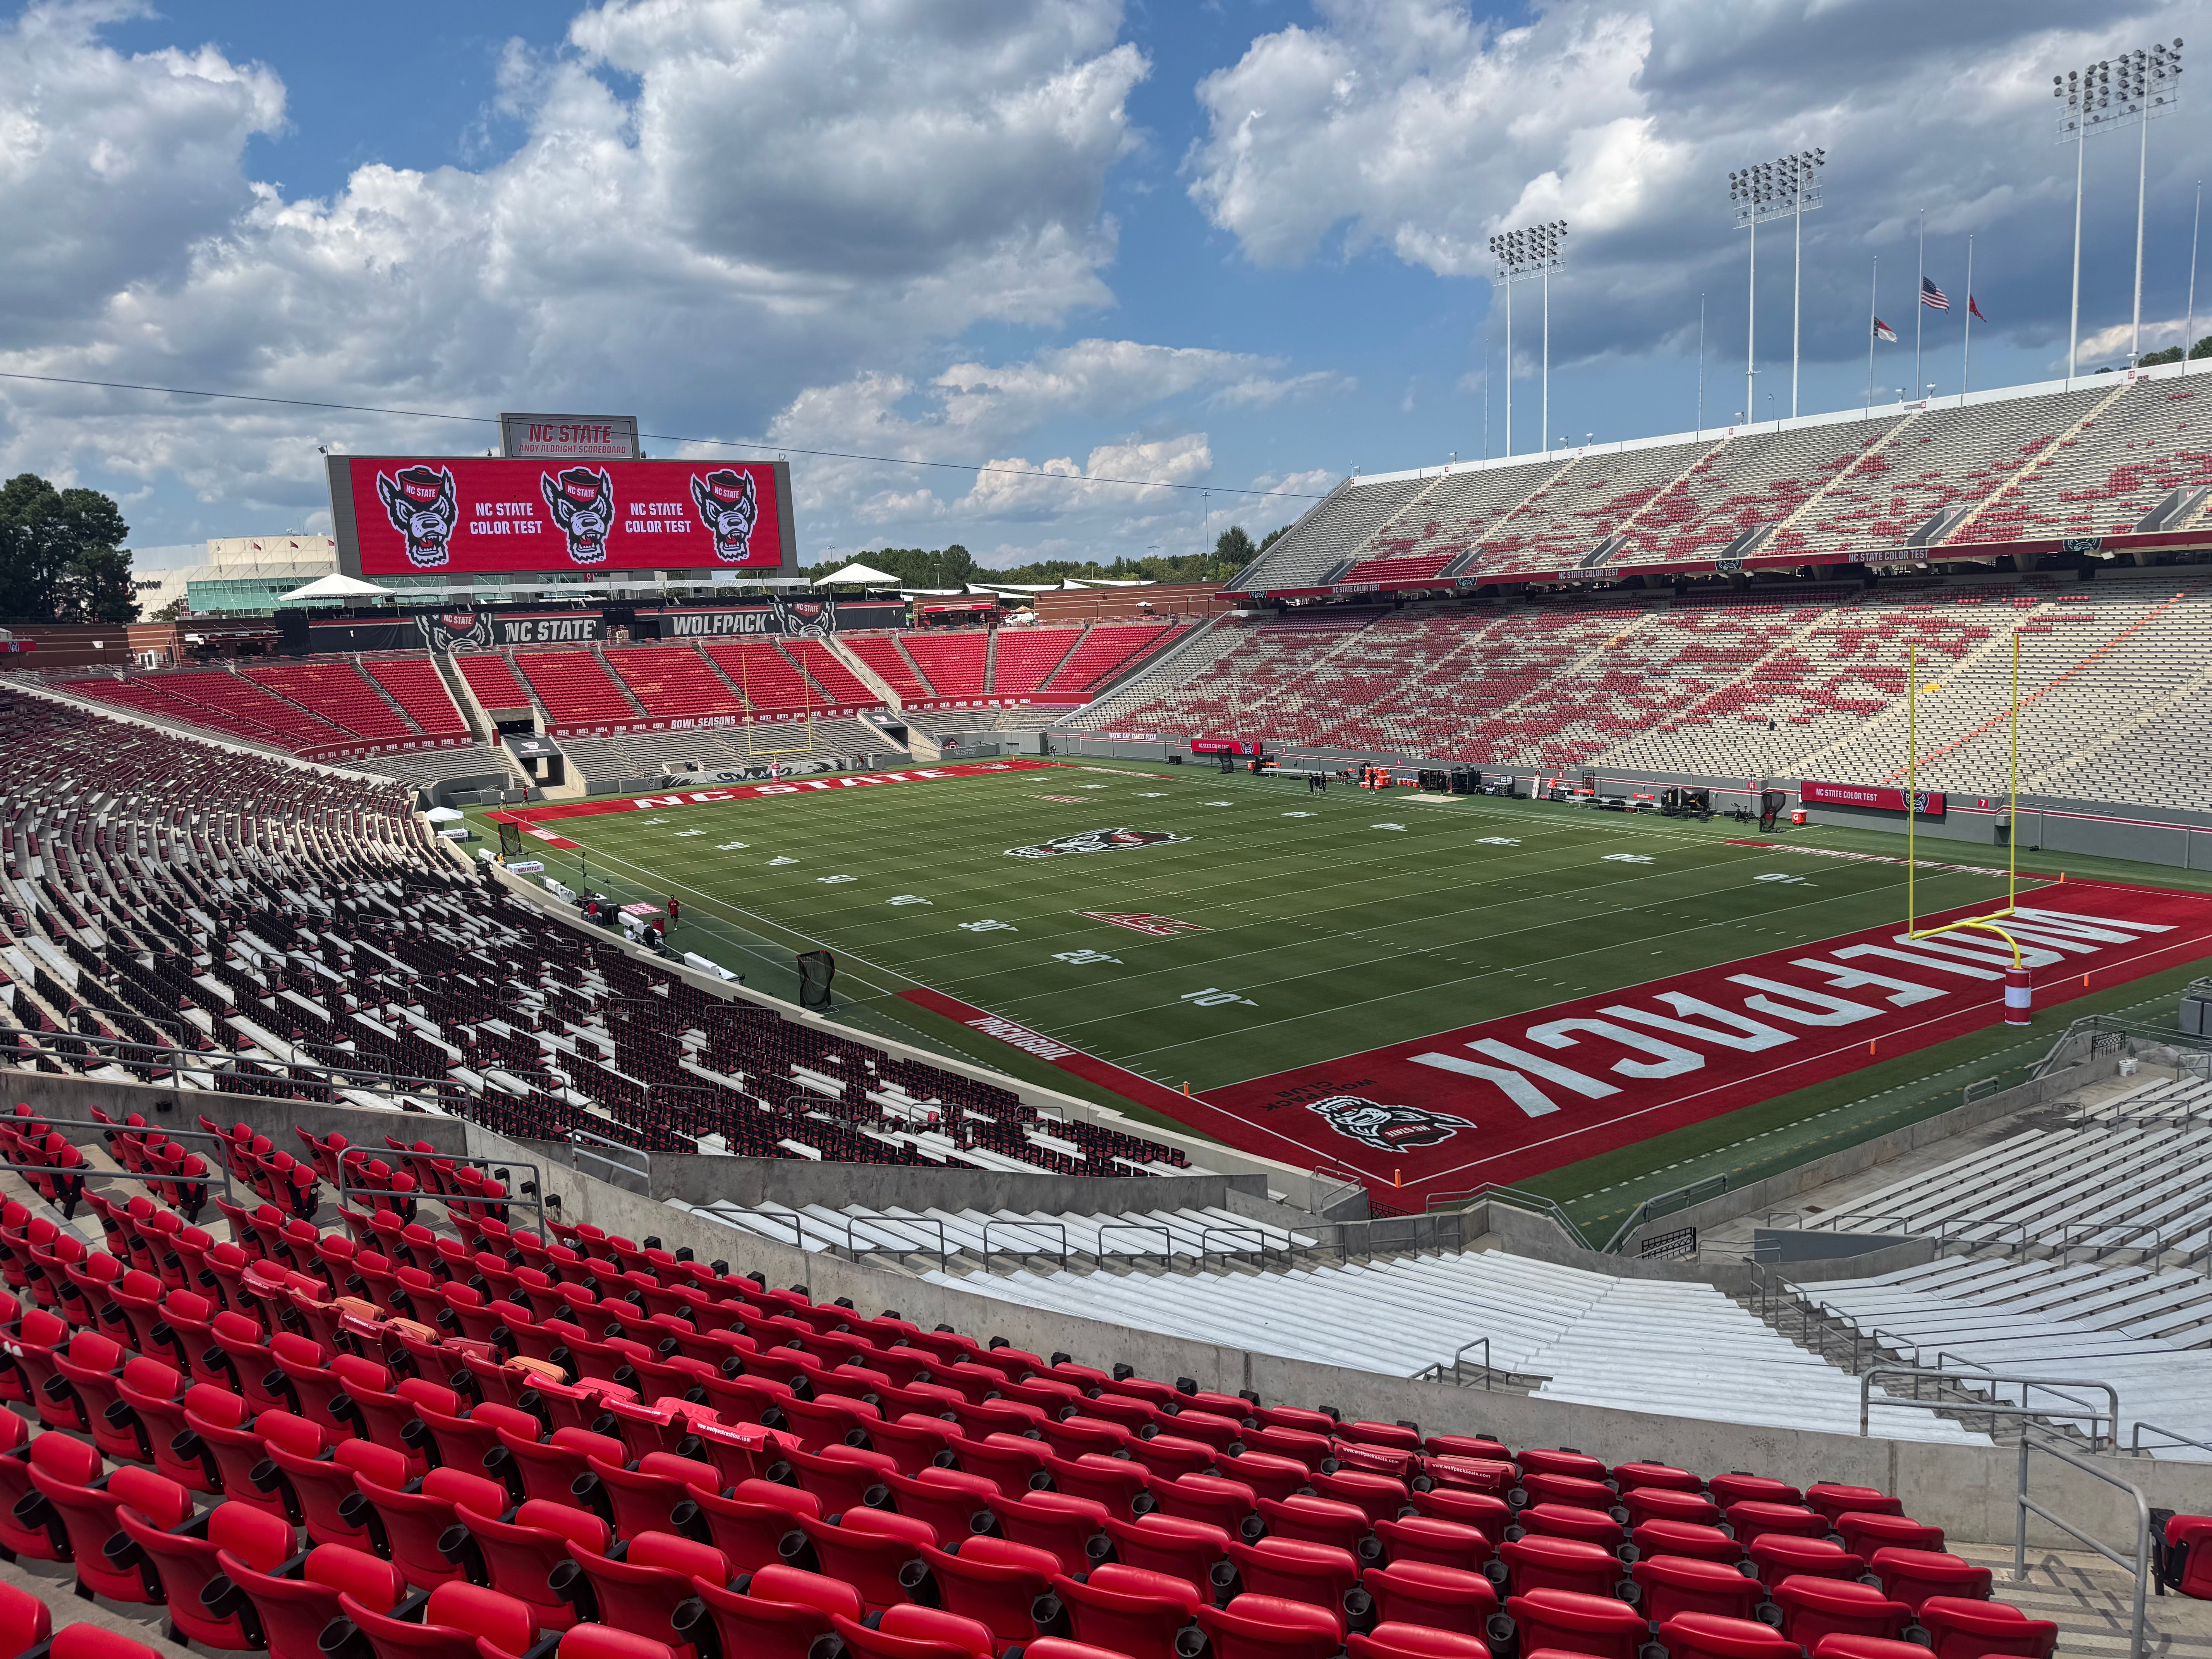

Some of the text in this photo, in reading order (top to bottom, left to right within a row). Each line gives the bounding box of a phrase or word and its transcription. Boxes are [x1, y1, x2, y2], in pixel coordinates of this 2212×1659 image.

[529, 424, 612, 444] NC STATE
[519, 444, 539, 452] ANDY
[579, 445, 625, 453] SCOREBOARD
[406, 484, 436, 498] NC STATE
[568, 485, 594, 497] NC STATE
[714, 486, 740, 498] NC STATE
[476, 503, 533, 516] NC STATE
[631, 503, 683, 515] NC STATE
[470, 521, 542, 534] COLOR TEST
[625, 520, 691, 533] COLOR TEST
[1849, 549, 1929, 562] NC STATE COLOR TEST
[1567, 570, 1584, 579] STATE
[1585, 569, 1603, 577] COLOR
[129, 580, 162, 590] Center
[796, 603, 819, 613] NC STATE
[444, 614, 472, 625] NC STATE
[672, 614, 767, 635] WOLFPACK
[507, 620, 594, 642] NC STATE
[671, 716, 735, 729] BOWL SEASONS
[633, 769, 957, 808] NC STATE
[1825, 789, 1842, 798] STATE
[1843, 791, 1862, 800] COLOR
[1863, 793, 1877, 801] TEST
[816, 874, 858, 884] 50
[1753, 873, 1806, 883] 10
[886, 895, 927, 905] 40
[958, 919, 1010, 931] 30
[1051, 950, 1112, 964] 20
[1181, 988, 1242, 1006] 10
[1406, 906, 2179, 1118] WOLFPACK
[1257, 1079, 1378, 1111] WOLFPACK
[1275, 1081, 1333, 1098] CLUB
[1385, 1127, 1415, 1137] STATE
[1343, 1447, 1399, 1464] www.wolfpackseats.com
[1432, 1463, 1491, 1479] www.wolfpackseats.com
